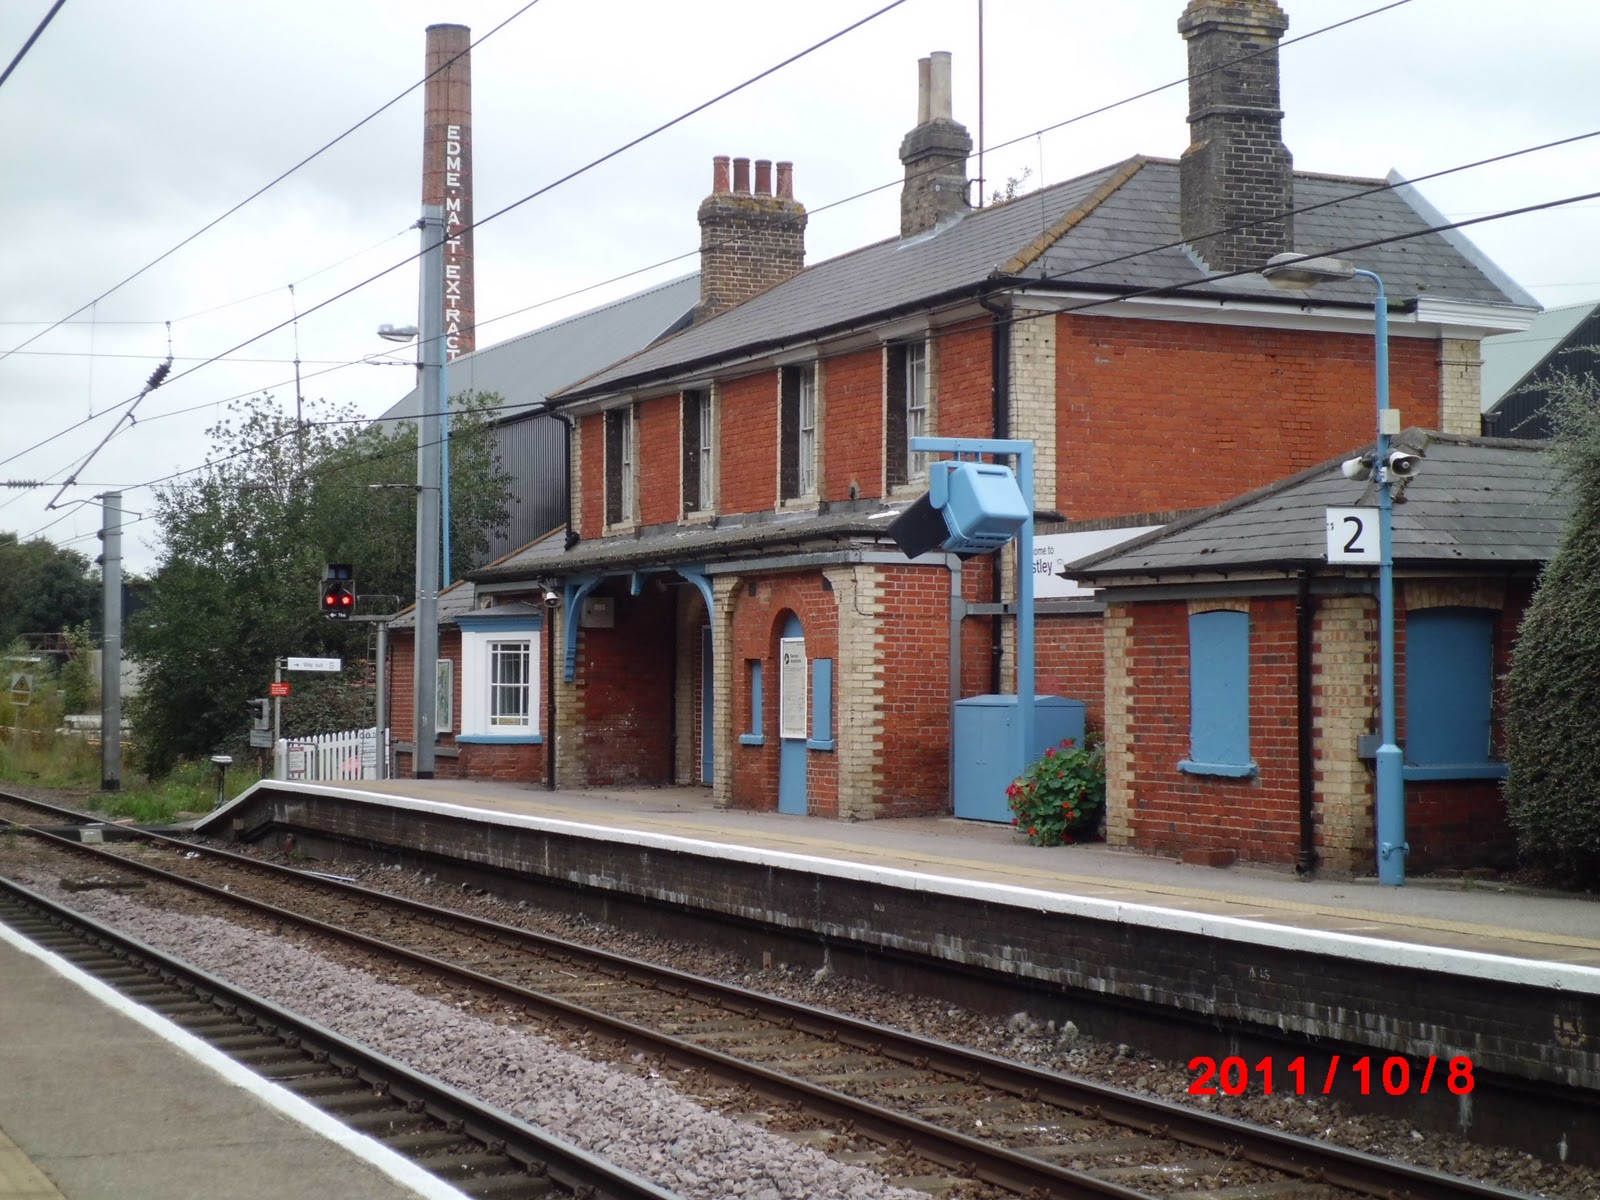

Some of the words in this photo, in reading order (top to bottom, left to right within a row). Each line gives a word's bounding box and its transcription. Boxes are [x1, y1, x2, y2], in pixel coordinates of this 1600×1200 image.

[446, 125, 461, 186] EDME
[446, 265, 461, 360] EXTRACT
[1047, 545, 1054, 555] to
[1343, 516, 1365, 553] 2
[1032, 558, 1052, 576] stley
